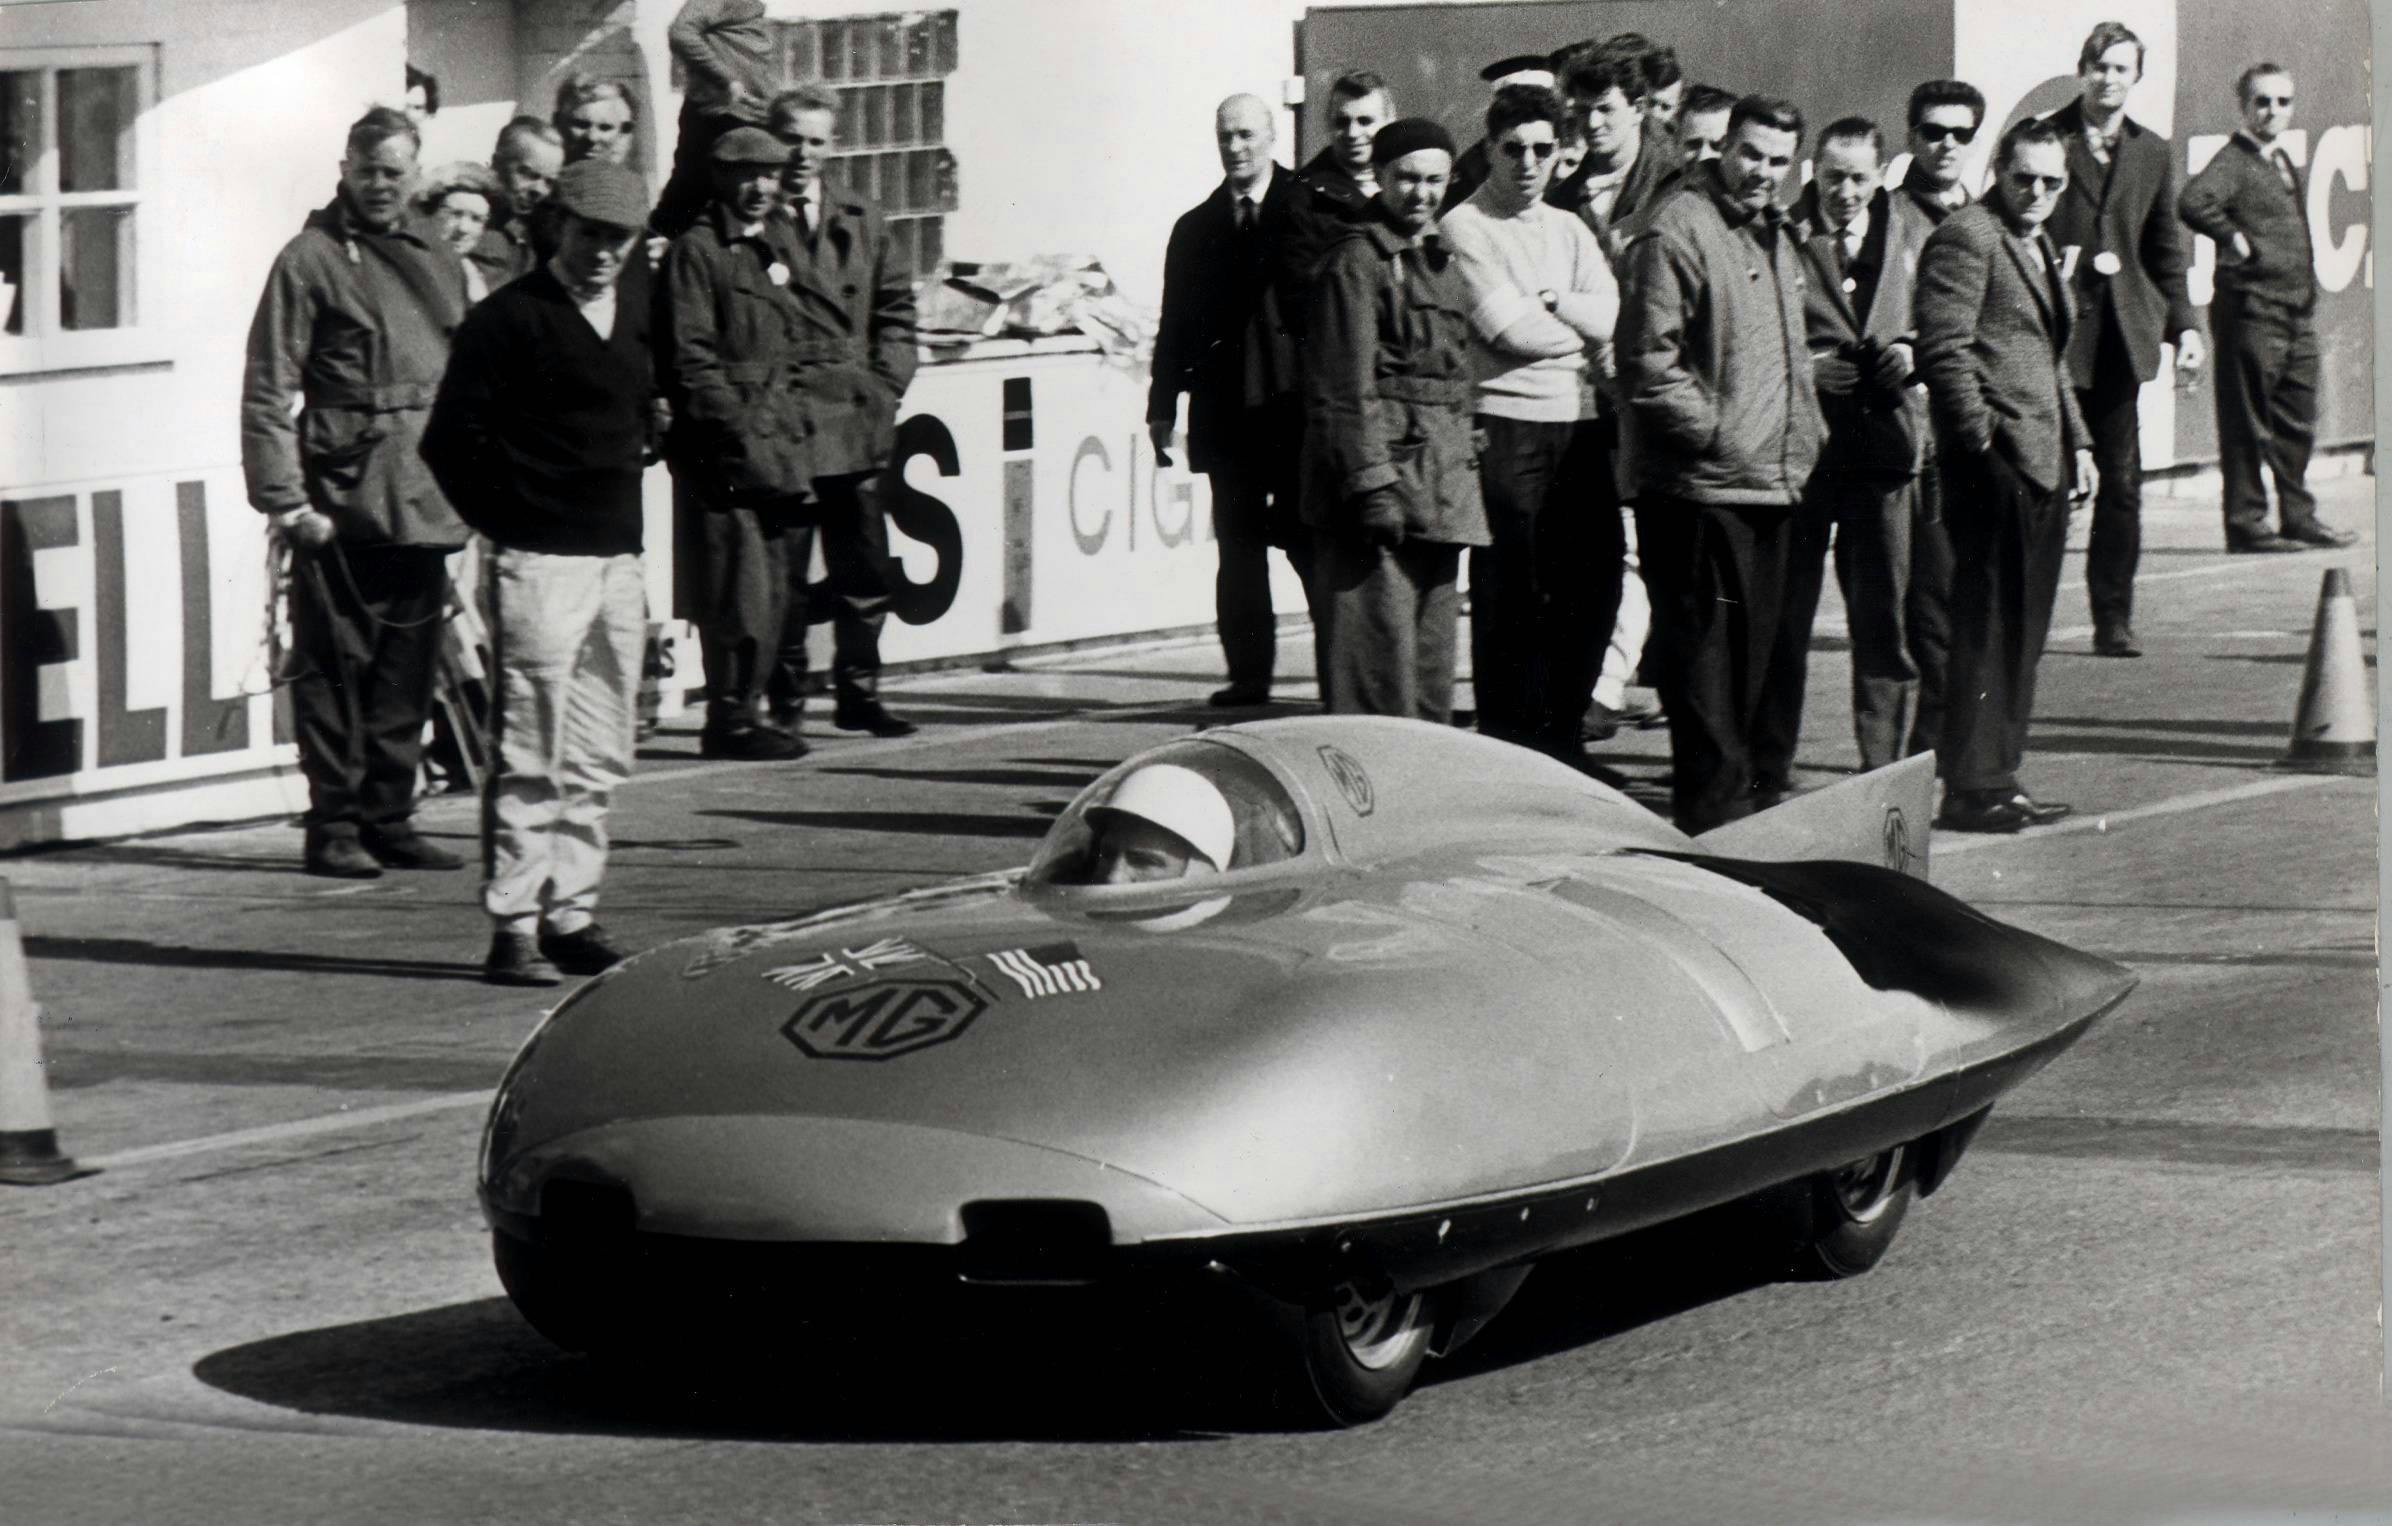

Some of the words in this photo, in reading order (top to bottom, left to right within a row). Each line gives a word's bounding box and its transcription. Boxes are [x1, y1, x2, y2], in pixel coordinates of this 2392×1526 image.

[1068, 433, 1217, 557] CIG
[0, 480, 296, 784] ELL
[806, 986, 959, 1048] MG
